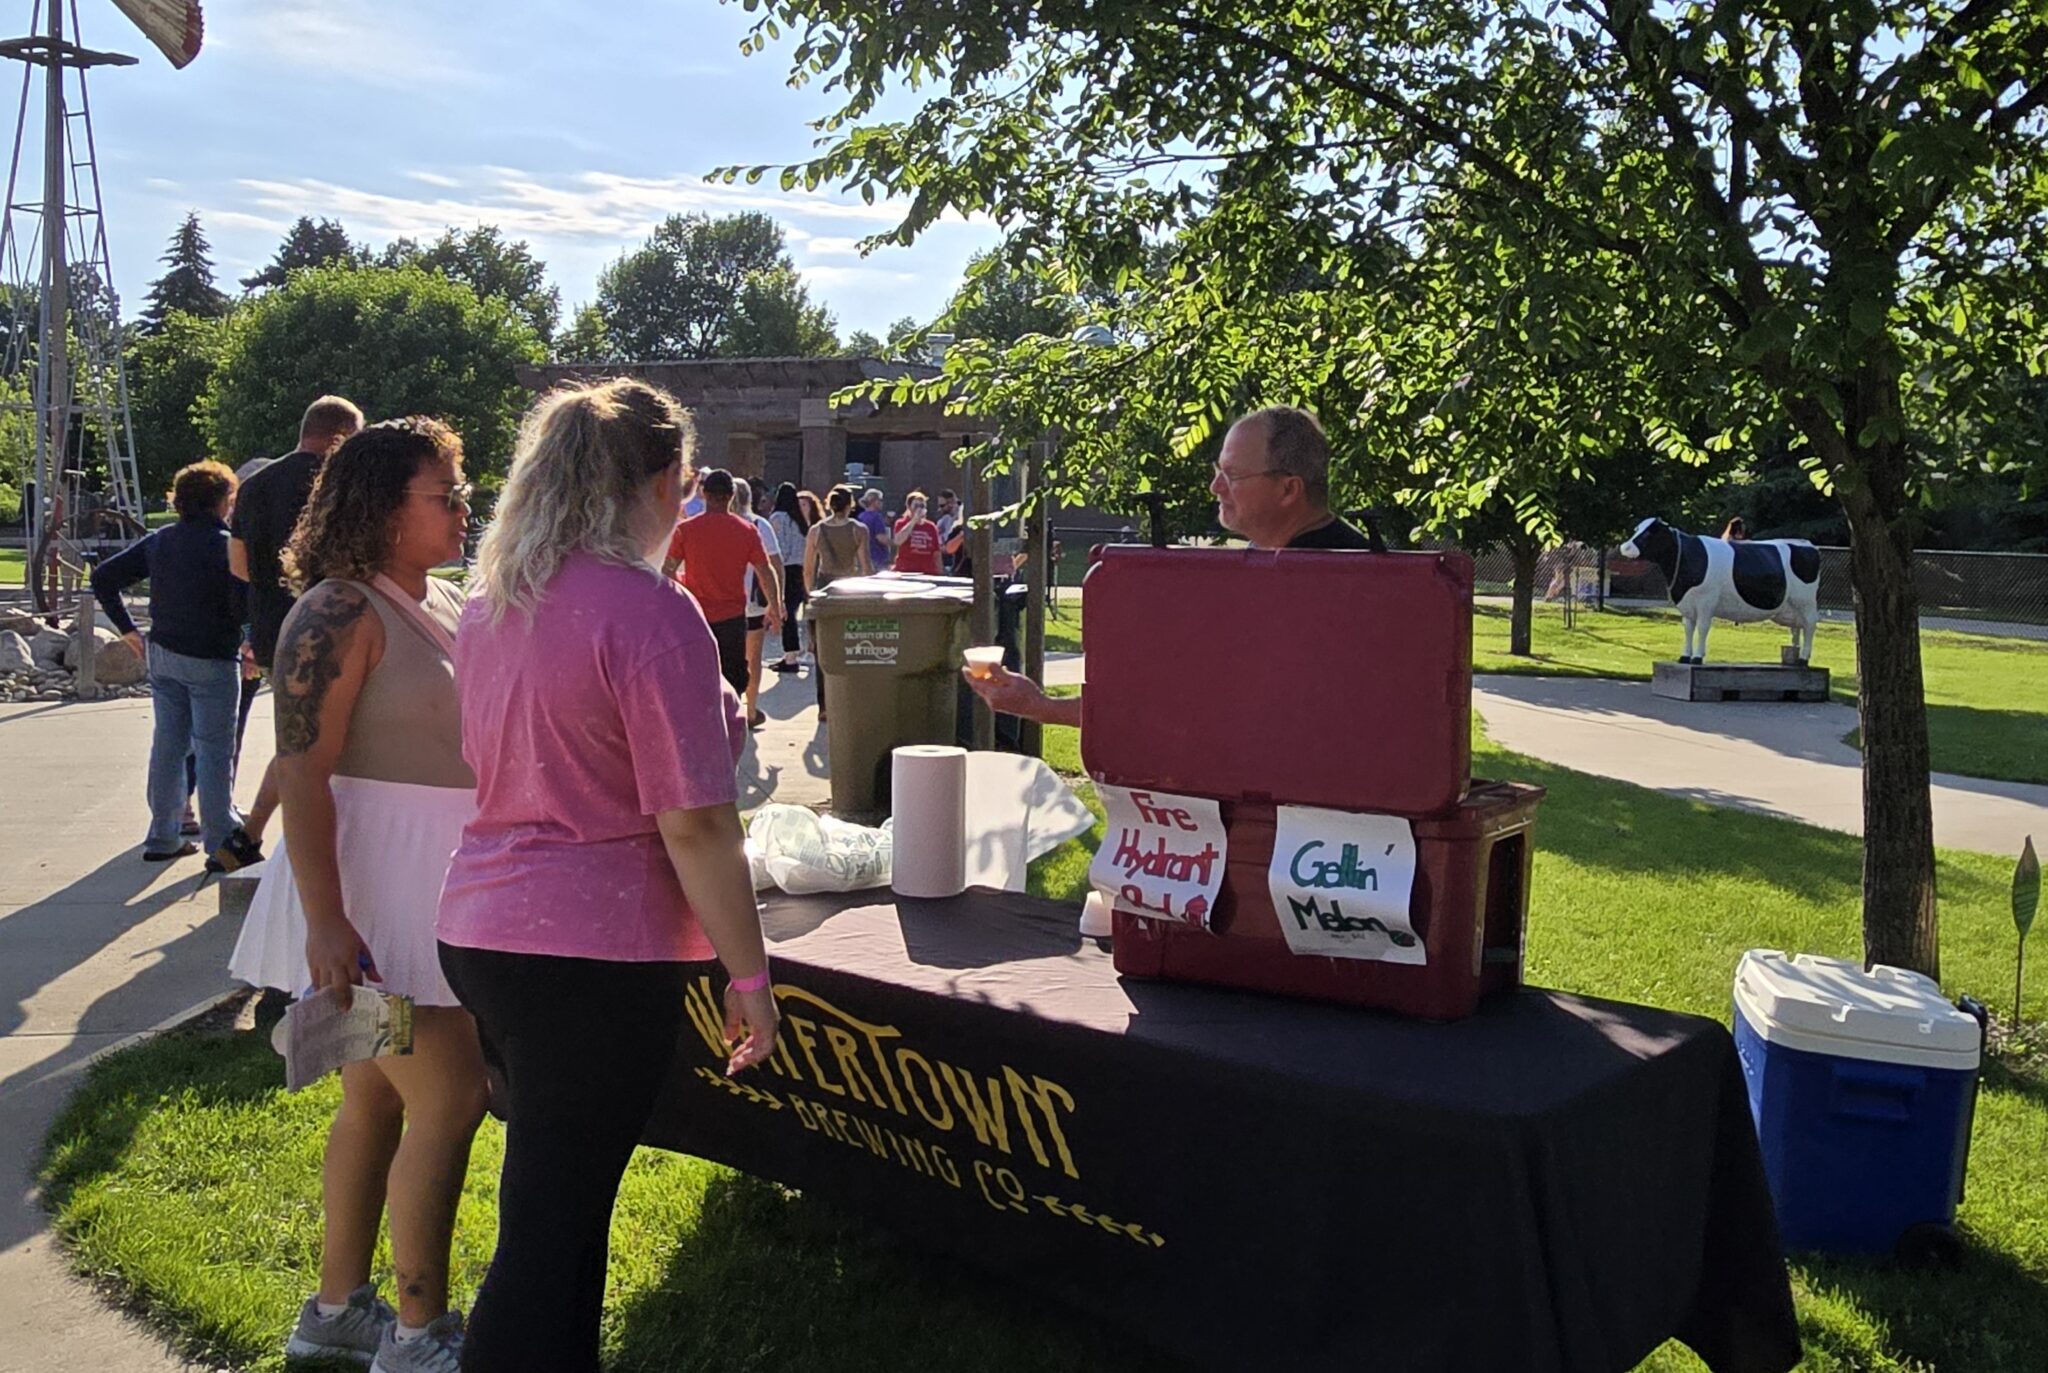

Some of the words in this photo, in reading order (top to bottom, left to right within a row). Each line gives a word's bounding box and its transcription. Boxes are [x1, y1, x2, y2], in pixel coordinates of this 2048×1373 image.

[1130, 791, 1198, 832] Fire
[1112, 828, 1219, 886] Hydrant
[1287, 895, 1388, 932] Melon
[684, 976, 1080, 1180] WTERTOWN
[787, 1094, 962, 1188] BREWING
